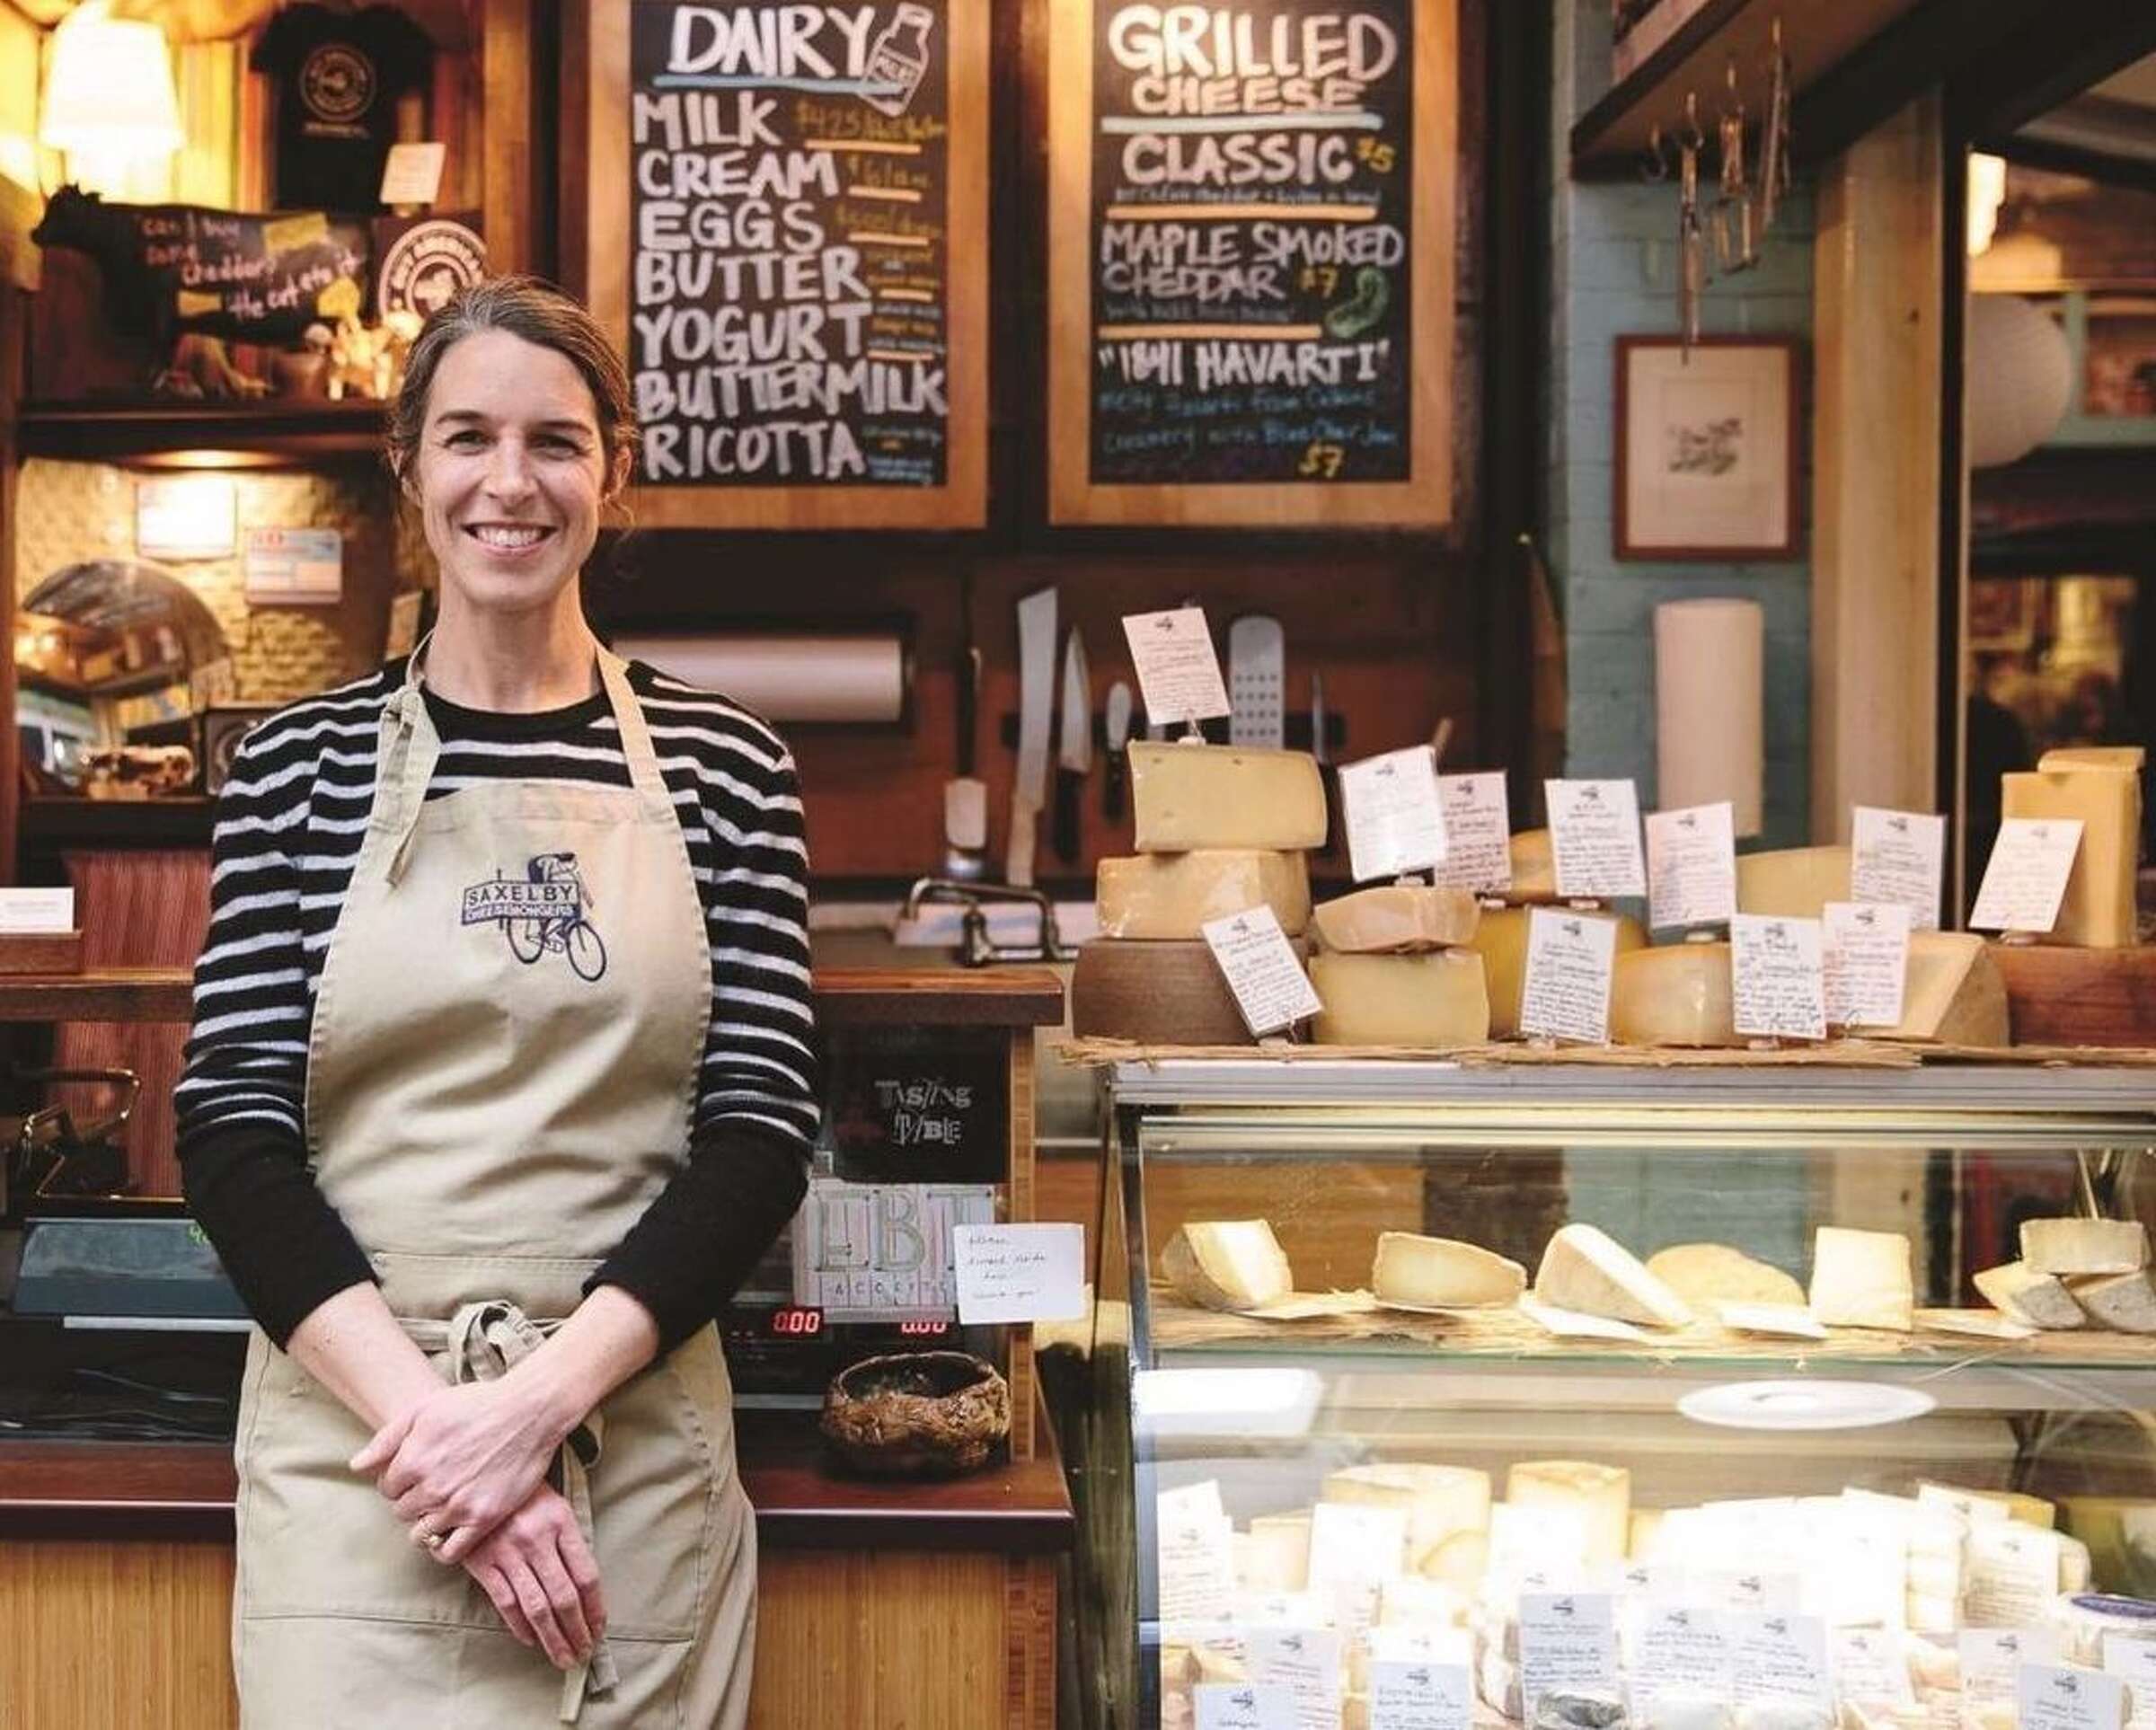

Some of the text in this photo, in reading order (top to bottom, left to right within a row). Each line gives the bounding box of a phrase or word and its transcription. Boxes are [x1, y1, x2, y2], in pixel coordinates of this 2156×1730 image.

[667, 5, 876, 78] DAIRY
[1107, 4, 1398, 82] GRILLED
[633, 91, 782, 150] MILK
[1130, 76, 1365, 115] CHEESE
[638, 149, 840, 198] CREAM
[1121, 134, 1394, 185] CLASSIC $5
[638, 200, 825, 252] EGGS
[1100, 221, 1404, 268] MAPLE SMOKED
[635, 245, 872, 305] BUTTER
[1101, 262, 1340, 303] CHEDDAR $7
[633, 302, 873, 367] YOGURT
[634, 359, 949, 422] BUTTERMILK
[642, 422, 867, 480] RICOTTA
[1297, 439, 1344, 479] $7
[468, 885, 572, 905] SAXELBY
